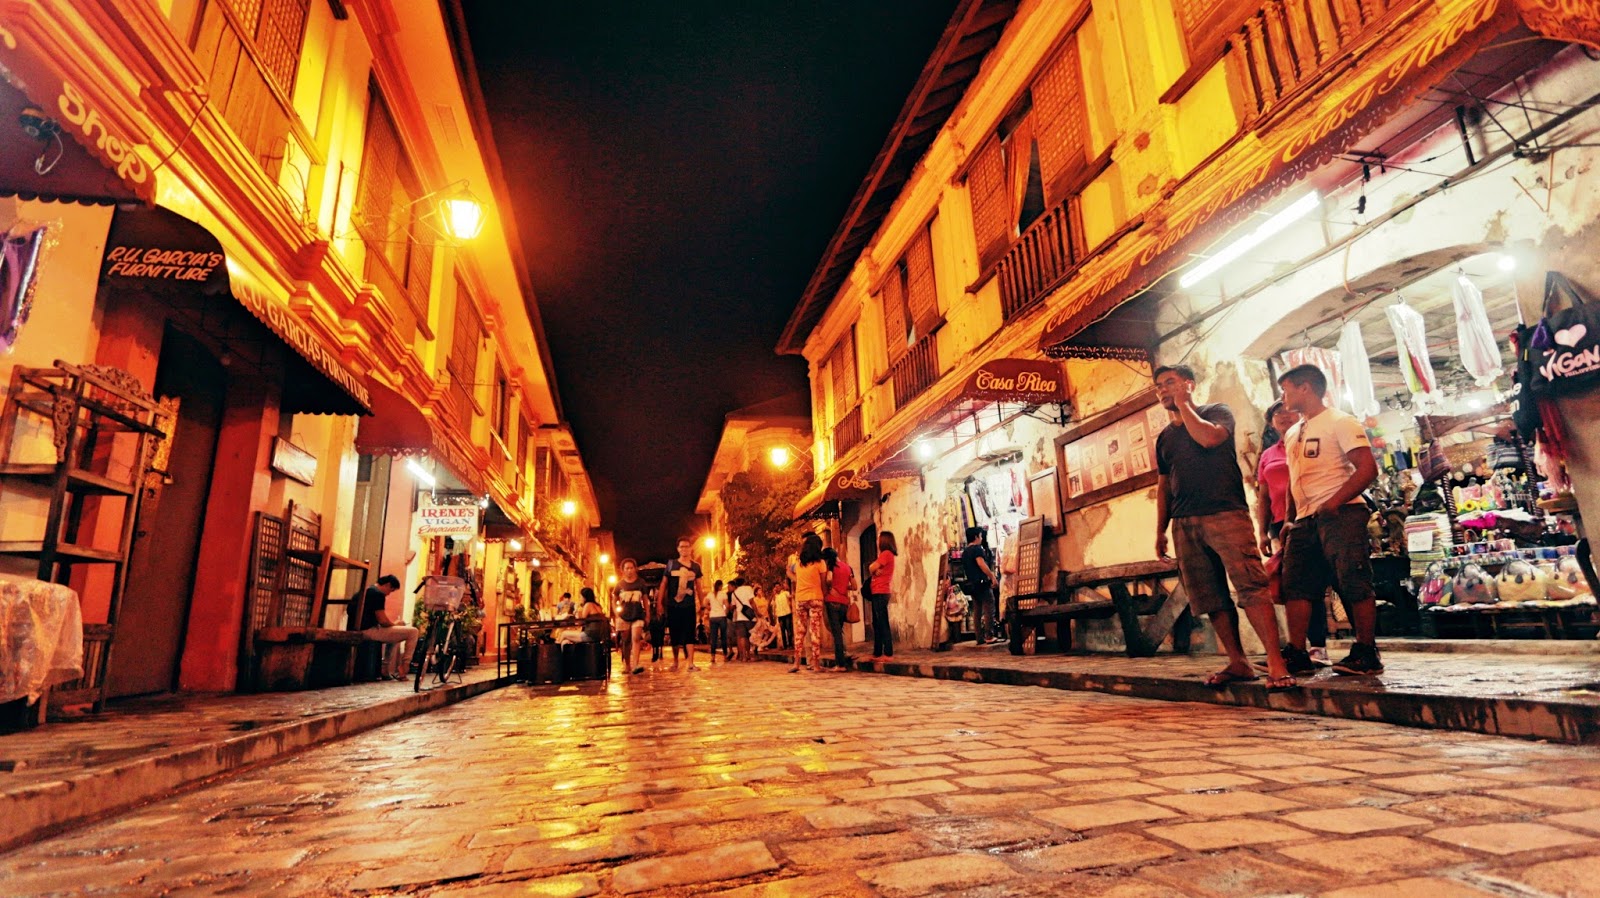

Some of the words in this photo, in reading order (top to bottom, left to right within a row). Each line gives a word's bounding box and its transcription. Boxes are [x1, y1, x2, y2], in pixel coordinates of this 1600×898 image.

[58, 81, 147, 183] Shop
[1139, 215, 1201, 266] Casa
[1282, 85, 1377, 163] Casa
[106, 246, 143, 263] R.U.
[142, 248, 223, 267] GARCIA'S
[107, 262, 213, 281] FURNITURE
[321, 347, 371, 408] FURNITURE
[976, 369, 1015, 390] Casa
[1016, 371, 1057, 392] Rica
[421, 508, 475, 518] IRENE'S
